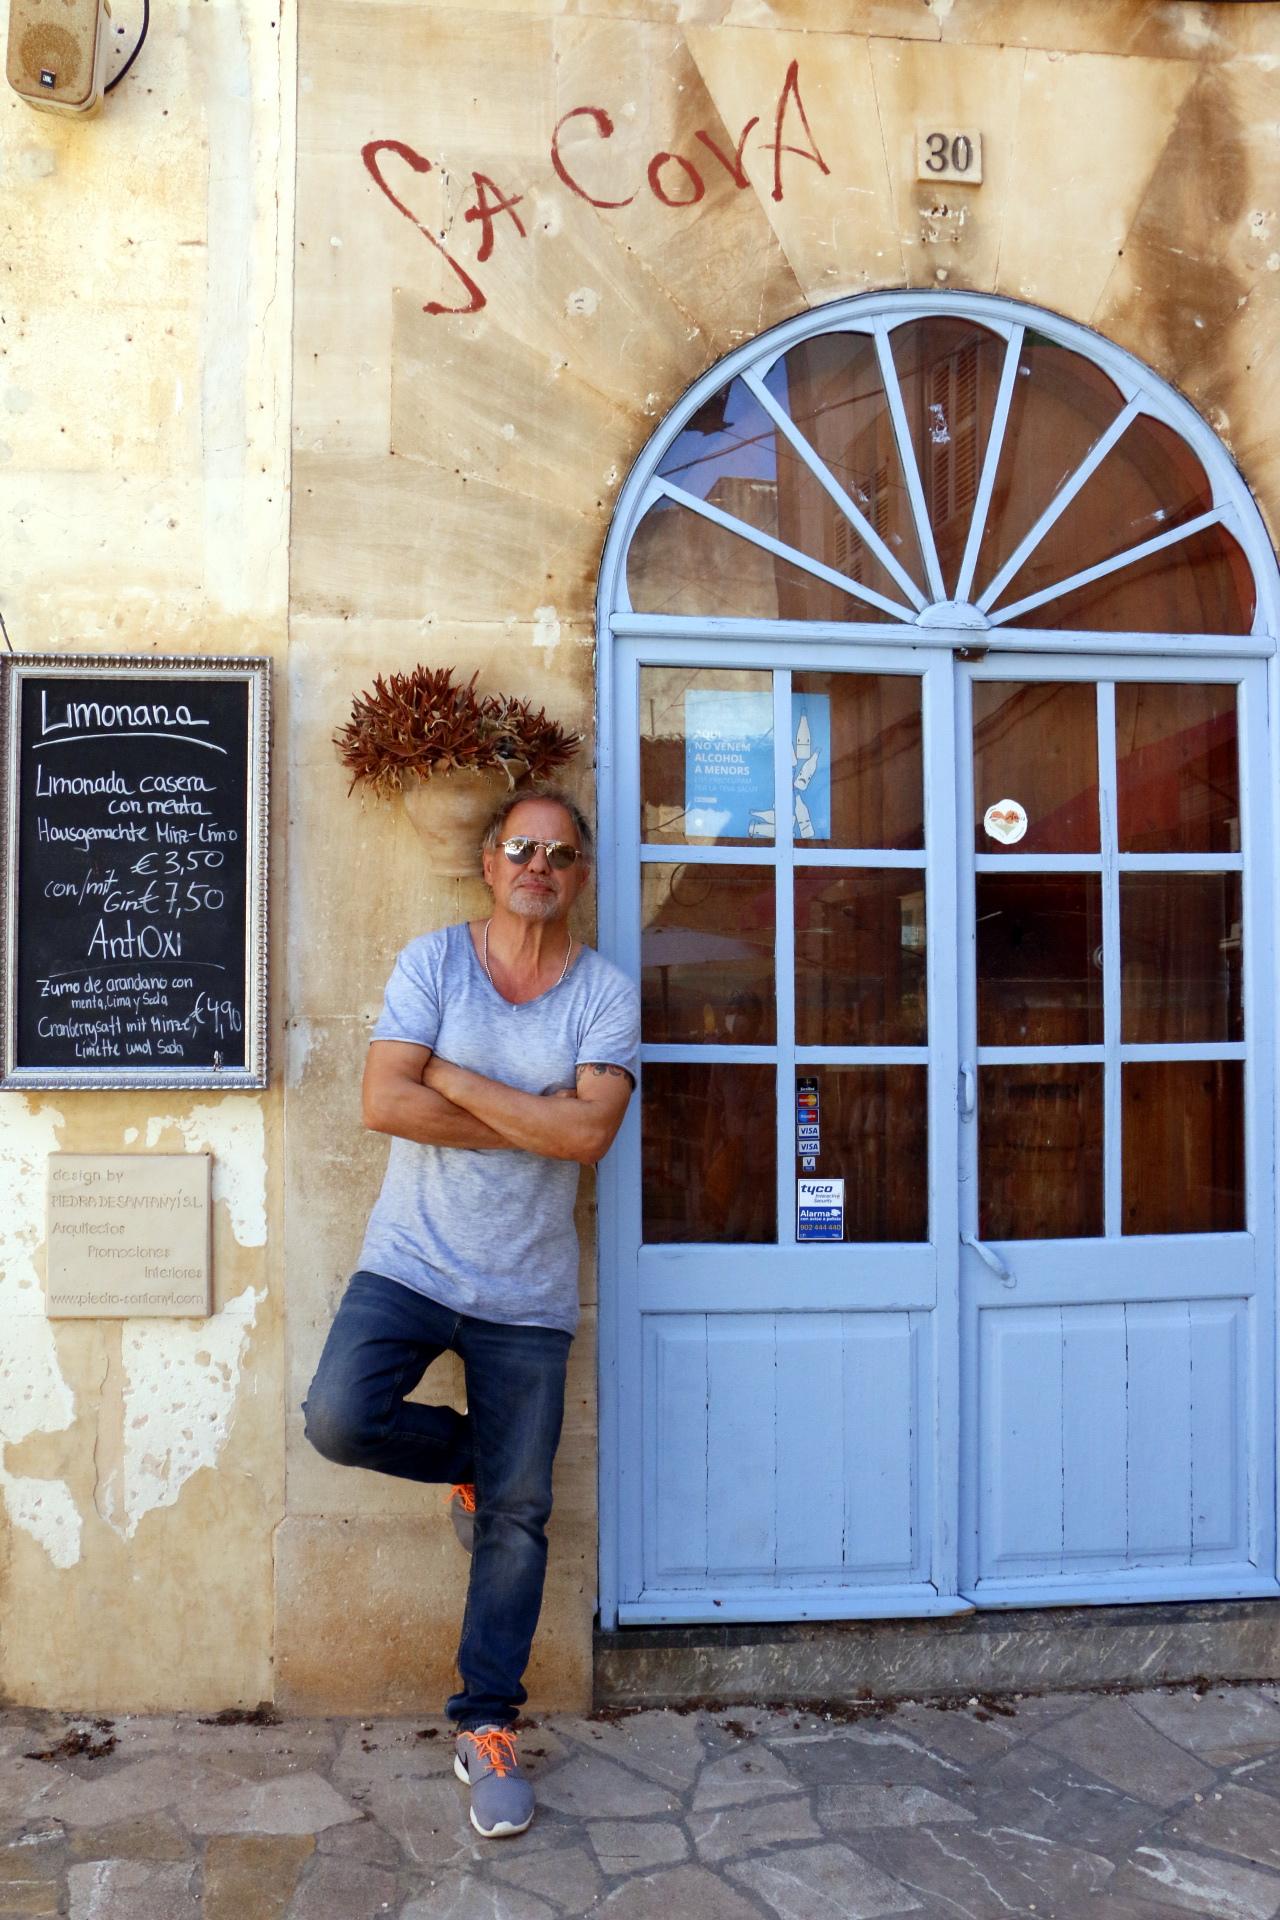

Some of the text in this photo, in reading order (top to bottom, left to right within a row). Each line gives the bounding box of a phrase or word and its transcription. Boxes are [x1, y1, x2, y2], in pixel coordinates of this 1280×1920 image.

[925, 132, 973, 173] 30
[362, 139, 527, 315] SA
[41, 690, 210, 735] Limonana
[695, 741, 751, 752] NO VENEM
[695, 753, 745, 764] ALCOHOL
[694, 765, 750, 776] A MENORS
[36, 764, 217, 797] Limonada casera
[108, 795, 213, 815] con menta
[38, 817, 150, 851] Hausgemachte
[36, 973, 193, 997] Zumo de arandano con
[133, 998, 141, 1015] y
[143, 992, 169, 1006] Soda
[38, 1015, 121, 1045] Cranberrysaft
[126, 1019, 147, 1032] mit
[75, 1038, 184, 1059] Limette und Soda
[801, 1127, 818, 1135] VISA
[801, 1143, 818, 1151] VISA
[52, 1168, 124, 1186] design by
[801, 1184, 833, 1195] tyco
[51, 1195, 97, 1208] PIEDRA
[800, 1209, 830, 1217] Alarma
[52, 1222, 125, 1237] Arquitectos
[87, 1245, 170, 1259] Promociones
[144, 1266, 203, 1279] Interiores
